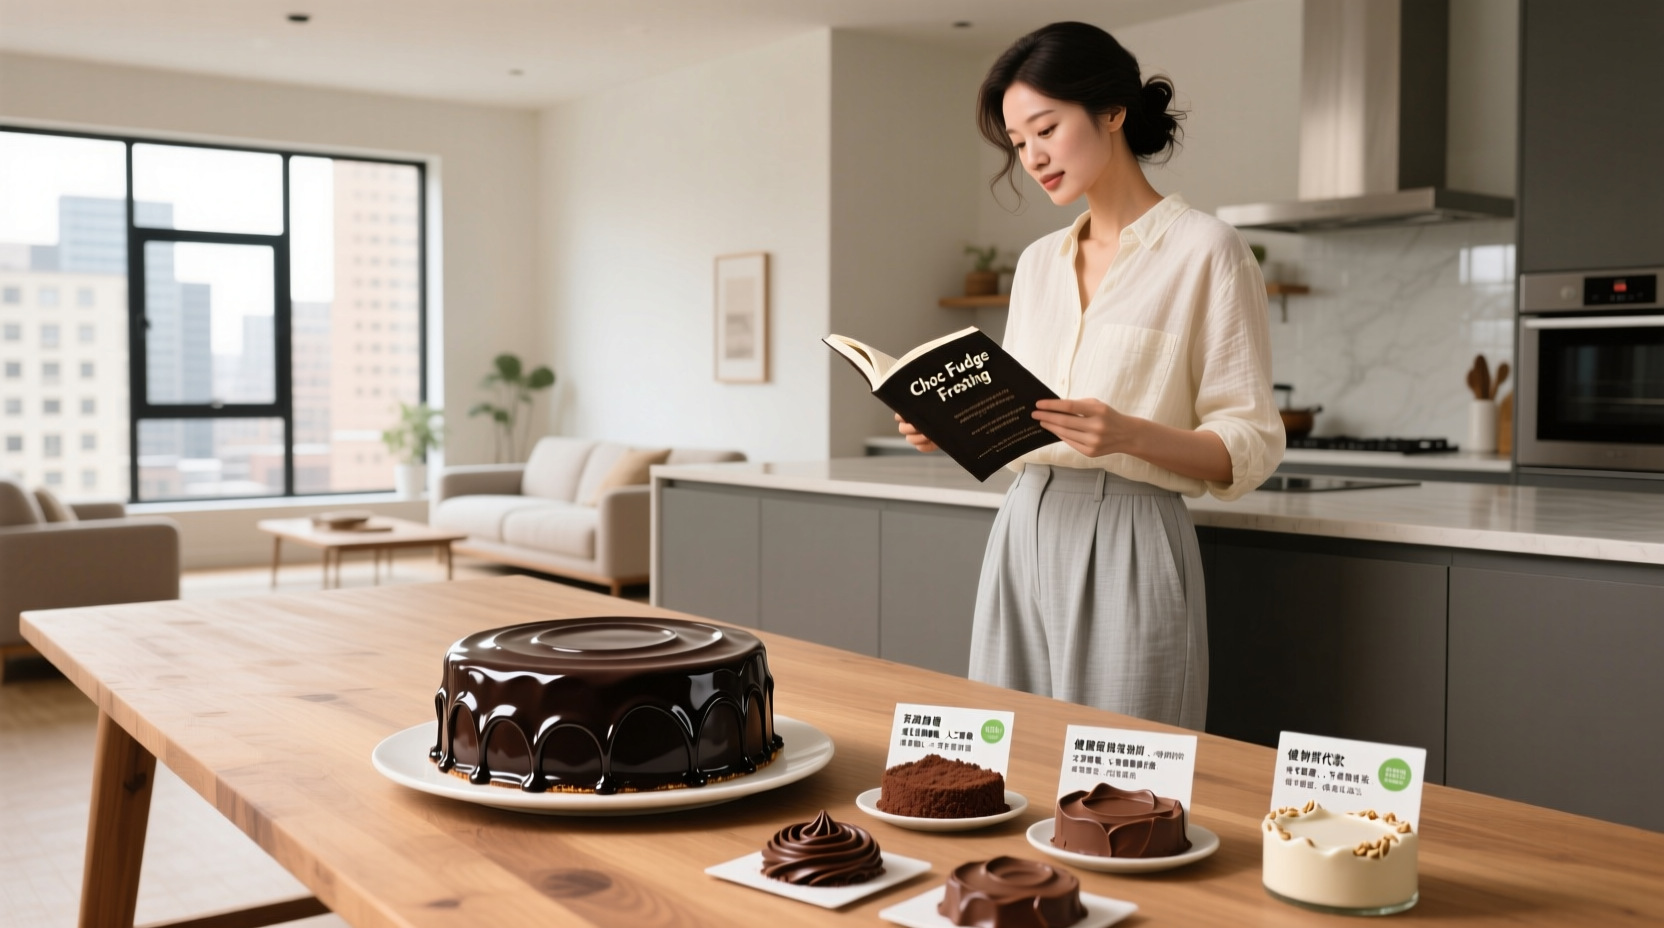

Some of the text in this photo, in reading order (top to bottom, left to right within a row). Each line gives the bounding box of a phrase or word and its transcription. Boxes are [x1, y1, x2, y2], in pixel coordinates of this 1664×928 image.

[910, 351, 990, 396] Choc Fudge
[937, 370, 992, 402] Frosting
